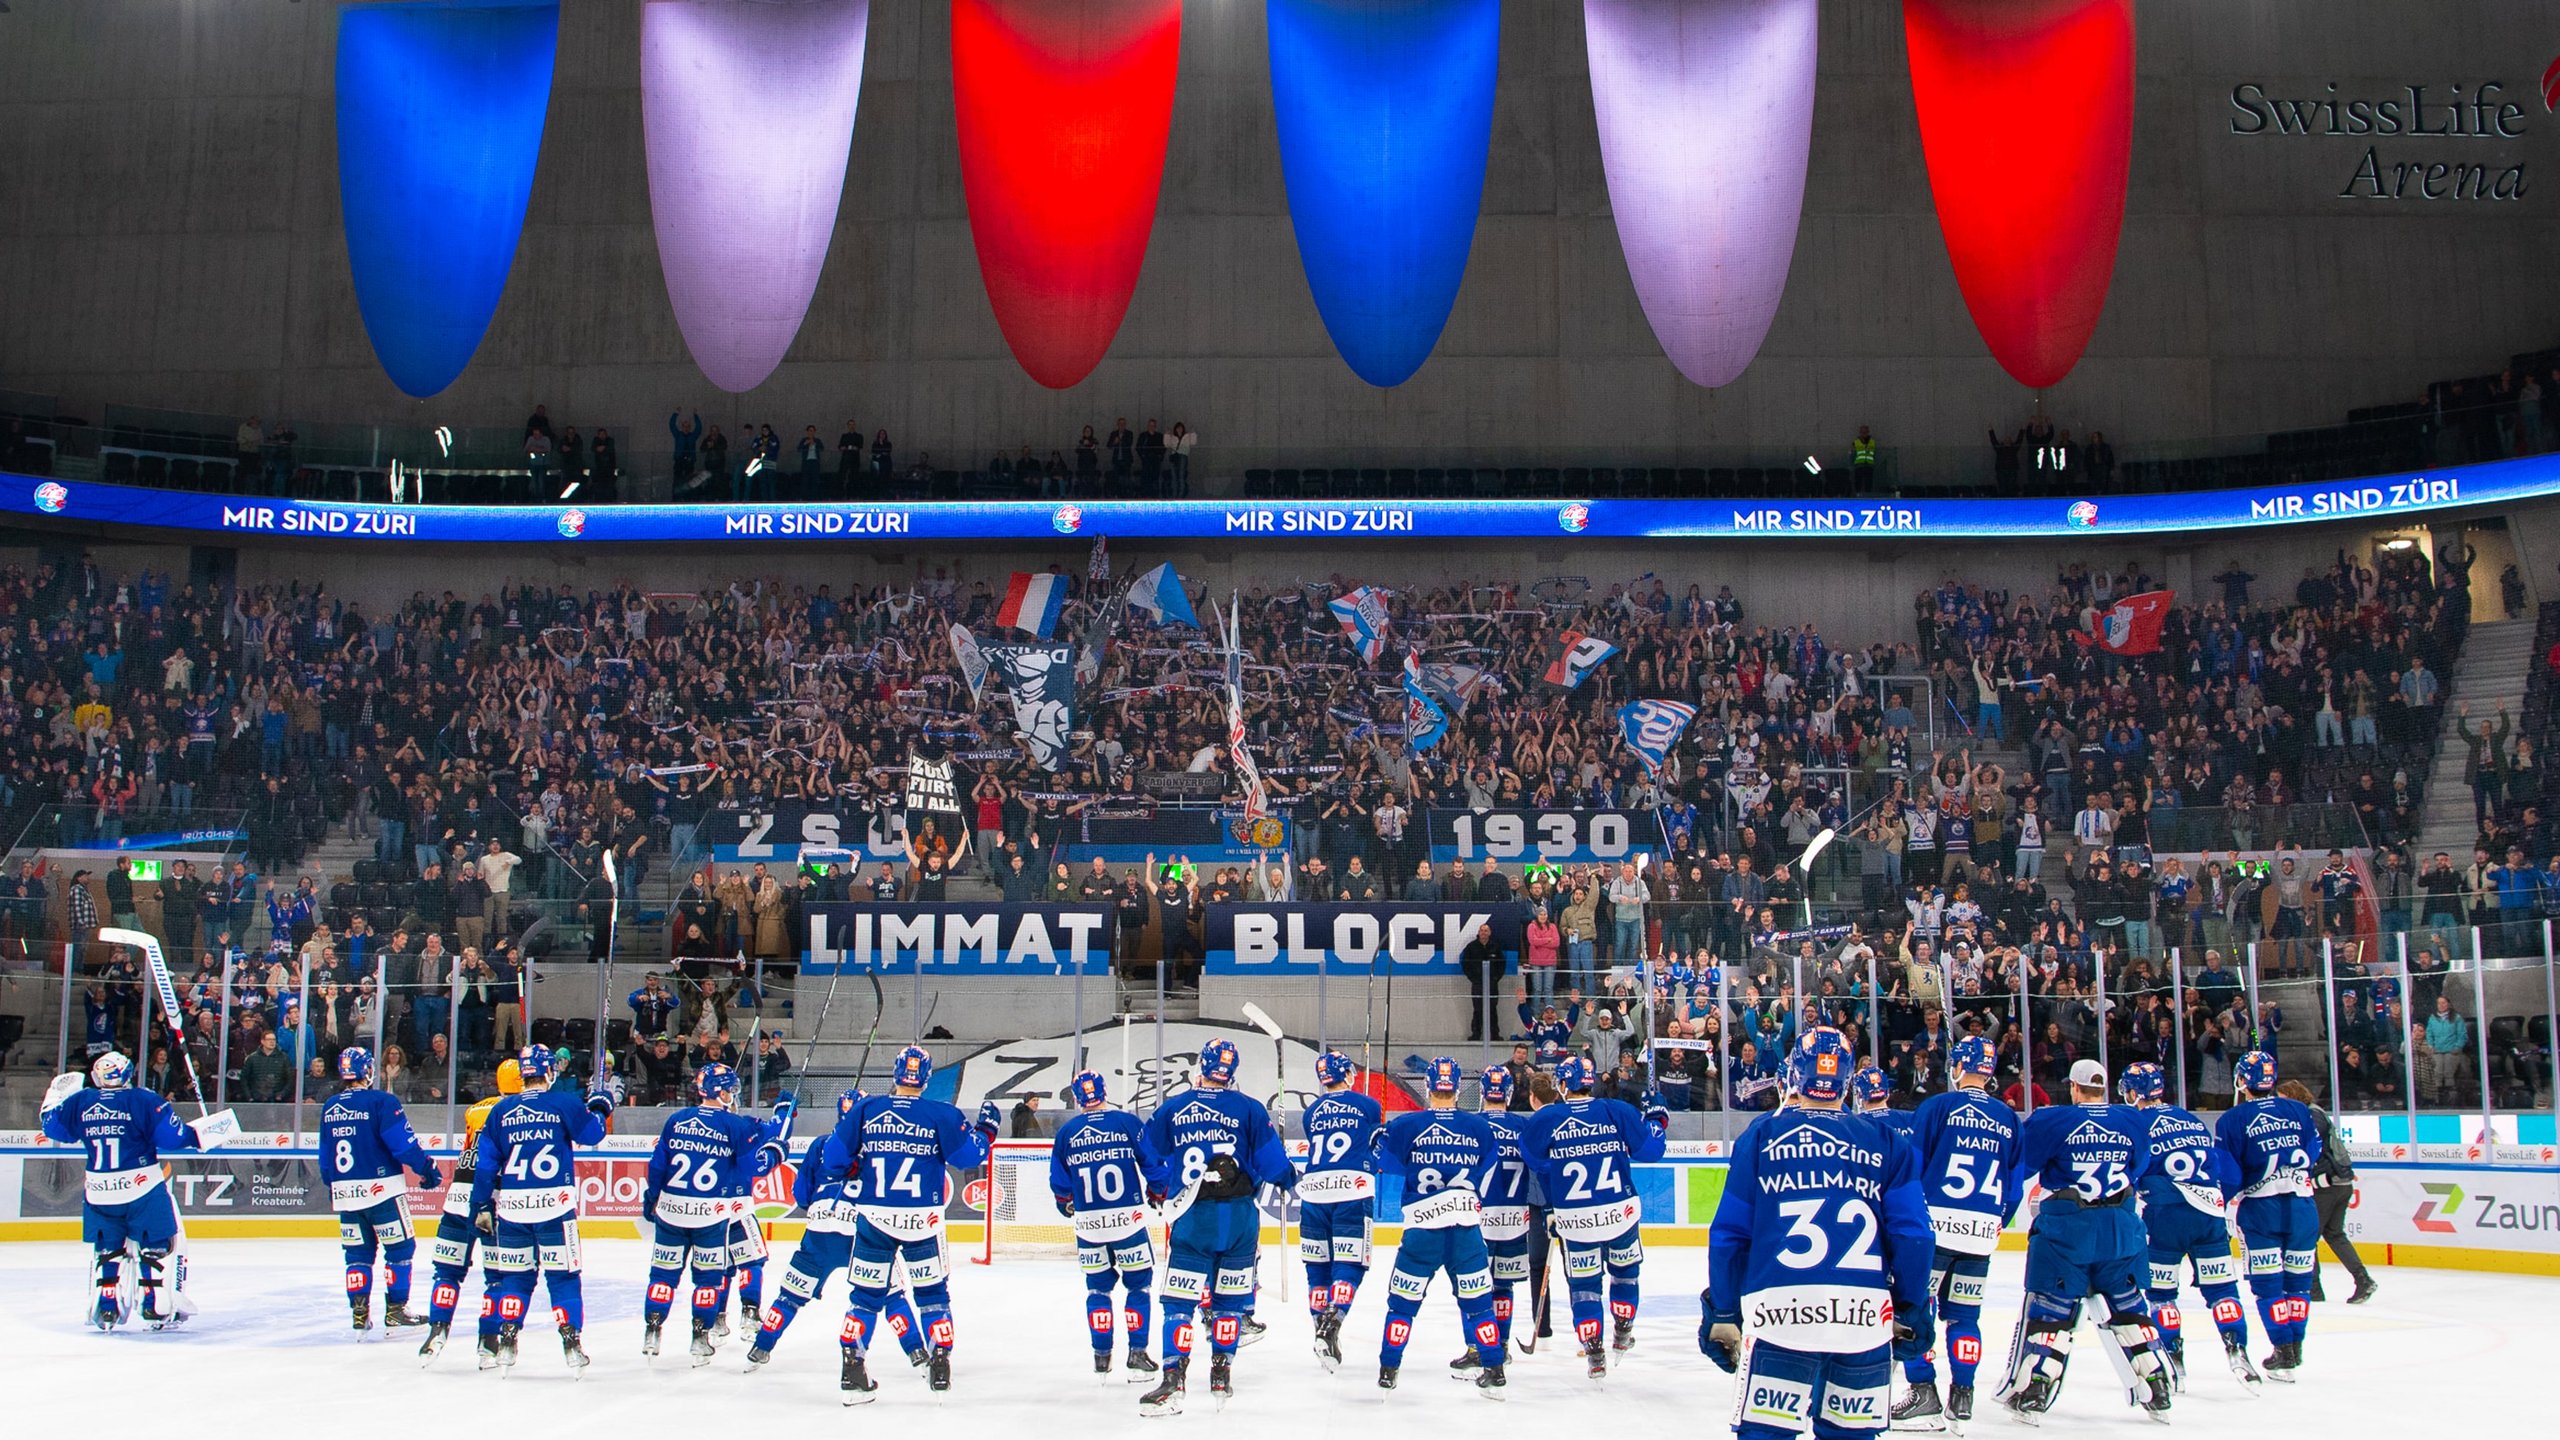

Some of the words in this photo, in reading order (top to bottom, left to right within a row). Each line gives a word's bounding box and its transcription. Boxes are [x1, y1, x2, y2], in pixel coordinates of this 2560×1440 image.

[2229, 81, 2527, 137] SwissLife
[2337, 146, 2529, 200] Arena
[2250, 496, 2304, 520] MIR
[2311, 488, 2384, 516] SIND
[2389, 477, 2459, 507] ZÜRI
[222, 506, 274, 529] MIR
[283, 509, 349, 533] SIND
[353, 509, 416, 535] ZÜRI
[725, 514, 773, 535] MIR
[780, 513, 844, 534] SIND
[848, 508, 909, 534] ZÜRI
[1225, 511, 1275, 532] MIR
[1282, 511, 1346, 532] SIND
[1351, 506, 1413, 531] ZÜRI
[1733, 510, 1783, 530] MIR
[1790, 510, 1855, 531] SIND
[1860, 505, 1921, 530] ZÜRI
[1452, 814, 1630, 858] 1930
[809, 912, 1104, 965] LIMMAT
[1233, 912, 1494, 964] BLOCK
[1815, 1080, 1832, 1088] 32
[85, 1126, 126, 1138] HRUBEC
[332, 1127, 357, 1138] RIEDI
[1310, 1116, 1359, 1133] SCHÄPPI
[508, 1129, 554, 1144] KUKAN
[607, 1138, 648, 1149] SwissLife
[1956, 1135, 1999, 1153] MARTI
[2258, 1134, 2301, 1153] TEXIER
[91, 1138, 120, 1171] 11
[335, 1139, 355, 1174] 8
[1311, 1131, 1352, 1166] 19
[2071, 1151, 2128, 1163] WAEBER
[2421, 1148, 2464, 1159] SwissLife
[2496, 1149, 2537, 1161] SwissLife
[504, 1144, 560, 1181] 46
[1412, 1151, 1480, 1166] TRUTMANN
[252, 1174, 271, 1184] Die
[667, 1153, 718, 1192] 26
[871, 1157, 922, 1198] 14
[1562, 1156, 1623, 1201] 24
[1941, 1152, 2002, 1206] 54
[251, 1185, 309, 1196] Cheminée-
[1078, 1163, 1125, 1204] 10
[1758, 1170, 1882, 1201] WALLMARK
[2071, 1162, 2130, 1203] 35
[251, 1197, 306, 1207] Kreateure.
[1776, 1199, 1883, 1272] 32
[434, 1243, 459, 1257] ewz
[500, 1252, 526, 1264] ewz
[655, 1250, 677, 1262] ewz
[694, 1249, 718, 1263] ewz
[1081, 1252, 1103, 1265] ewz
[1116, 1249, 1145, 1264] ewz
[1496, 1259, 1522, 1272] ewz
[1571, 1254, 1596, 1269] ewz
[2252, 1252, 2278, 1267] ewz
[2284, 1252, 2312, 1266] ewz
[853, 1266, 881, 1280] ewz
[2200, 1262, 2227, 1276] ewz
[785, 1271, 808, 1290] ewz
[1169, 1274, 1197, 1290] ewz
[1220, 1273, 1247, 1286] ewz
[1392, 1274, 1421, 1292] ewz
[1459, 1274, 1487, 1290] ewz
[1953, 1280, 1982, 1296] ewz
[1752, 1298, 1877, 1328] SwissLife
[1753, 1386, 1801, 1413] ewz
[1827, 1392, 1876, 1415] ewz
